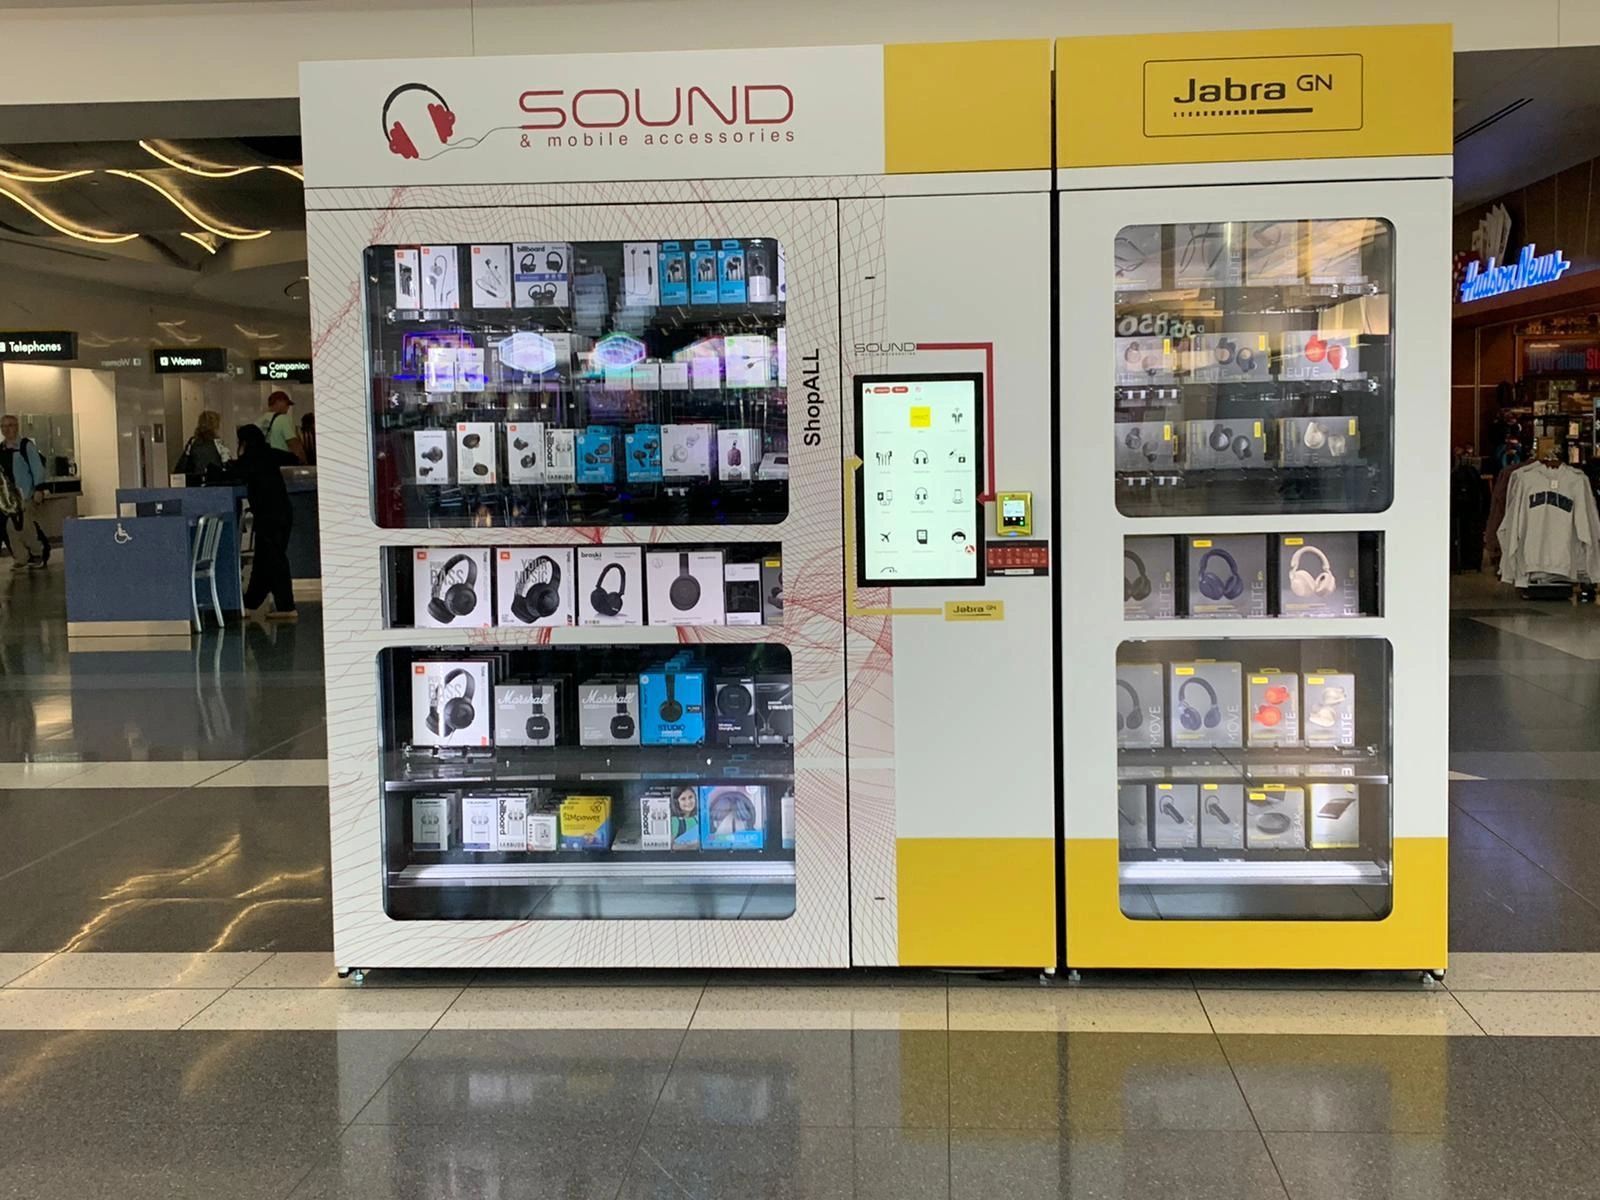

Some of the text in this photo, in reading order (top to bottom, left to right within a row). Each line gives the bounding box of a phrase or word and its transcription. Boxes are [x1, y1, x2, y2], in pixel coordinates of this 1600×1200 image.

[1173, 74, 1333, 104] Jabra GN
[519, 85, 795, 130] SOUND
[520, 130, 796, 148] & mobile accessories
[516, 245, 546, 253] billboard
[1460, 243, 1571, 303] Hudson News
[9, 341, 62, 355] Telephones
[854, 342, 916, 353] SOUND
[170, 356, 202, 367] Women
[269, 362, 310, 373] Companion
[269, 370, 288, 379] Care
[1286, 366, 1320, 378] ELITE
[802, 348, 824, 446] ShopALL
[546, 431, 555, 468] billboard
[520, 558, 548, 570] YOUR
[580, 551, 602, 559] broski
[430, 569, 465, 586] BASS
[514, 570, 549, 584] MUSIC
[1160, 583, 1171, 618] ELITE
[1251, 582, 1264, 616] ELITE
[1343, 579, 1356, 616] ELITE
[953, 605, 984, 613] Jabra
[496, 689, 551, 705] Marshall
[582, 689, 635, 704] Marshall
[1149, 705, 1161, 745] MOVE
[1228, 704, 1239, 743] MOVE
[1286, 712, 1297, 744] ELITE
[1341, 712, 1353, 744] ELITE
[499, 800, 508, 836] billboard
[642, 800, 651, 836] billboard
